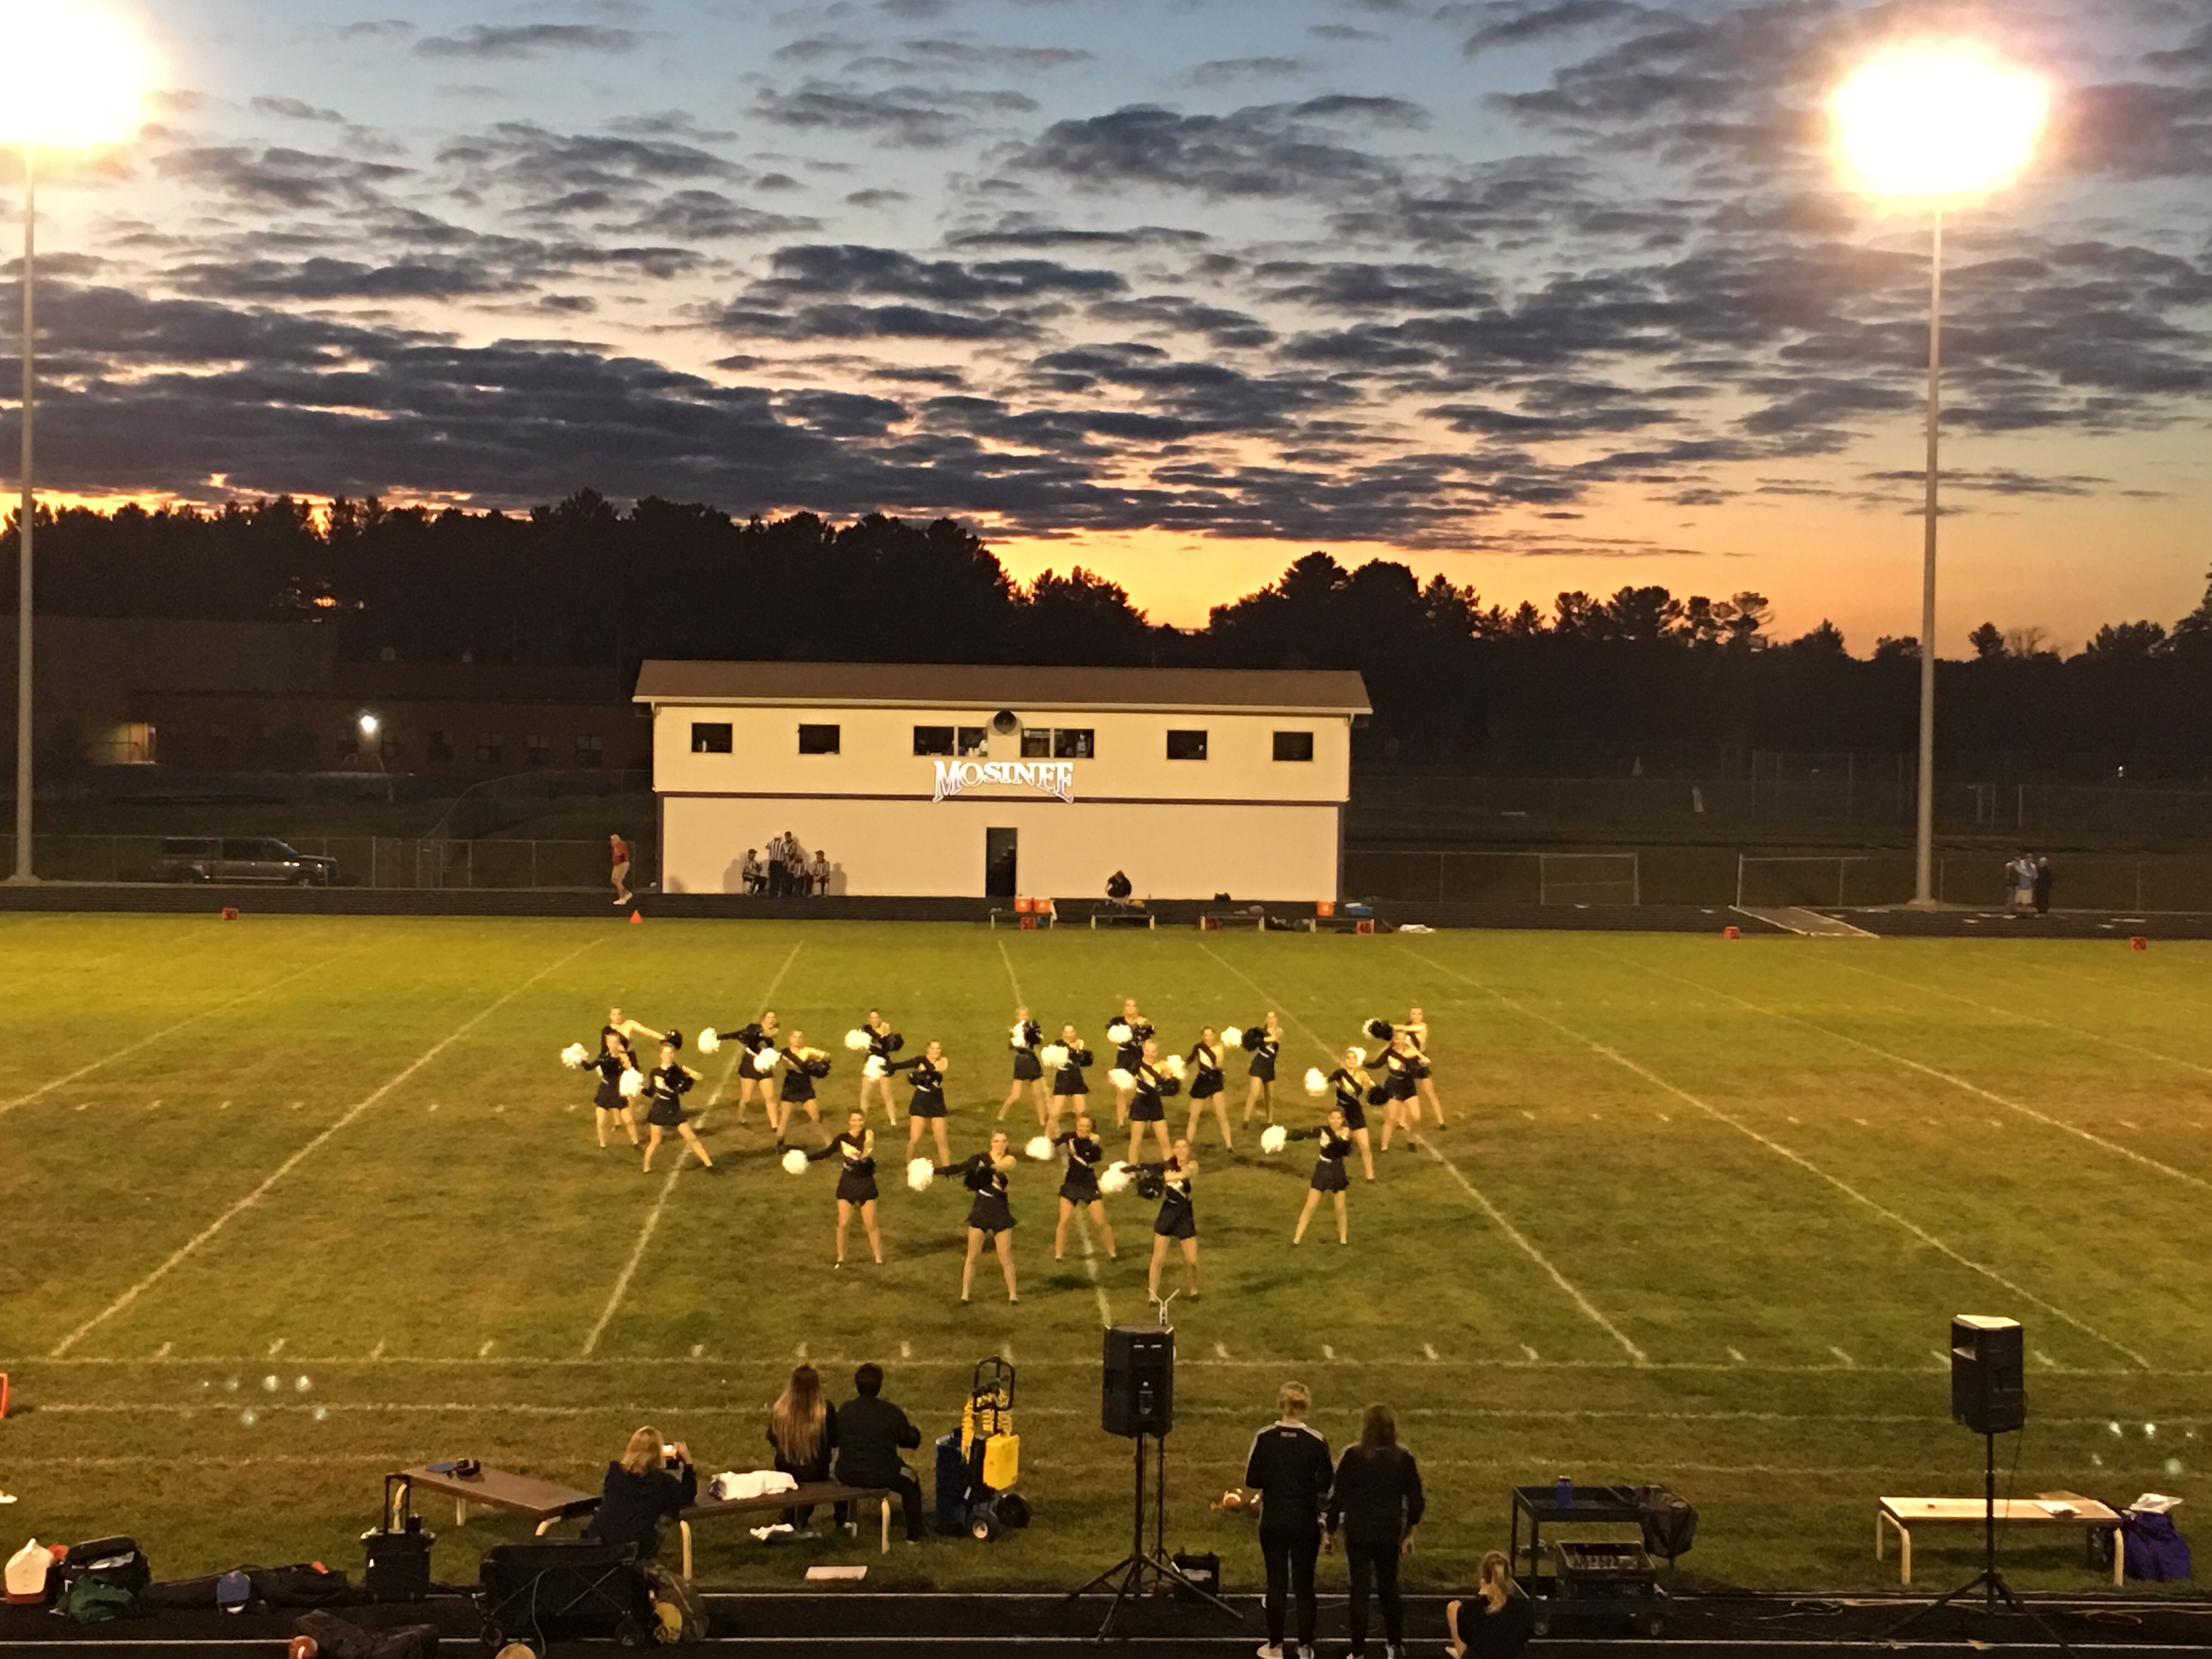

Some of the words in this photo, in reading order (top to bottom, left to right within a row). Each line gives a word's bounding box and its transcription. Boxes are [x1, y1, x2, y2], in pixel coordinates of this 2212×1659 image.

[933, 760, 1074, 803] MOSINEE
[1023, 918, 1035, 930] 50
[2133, 939, 2146, 950] 20
